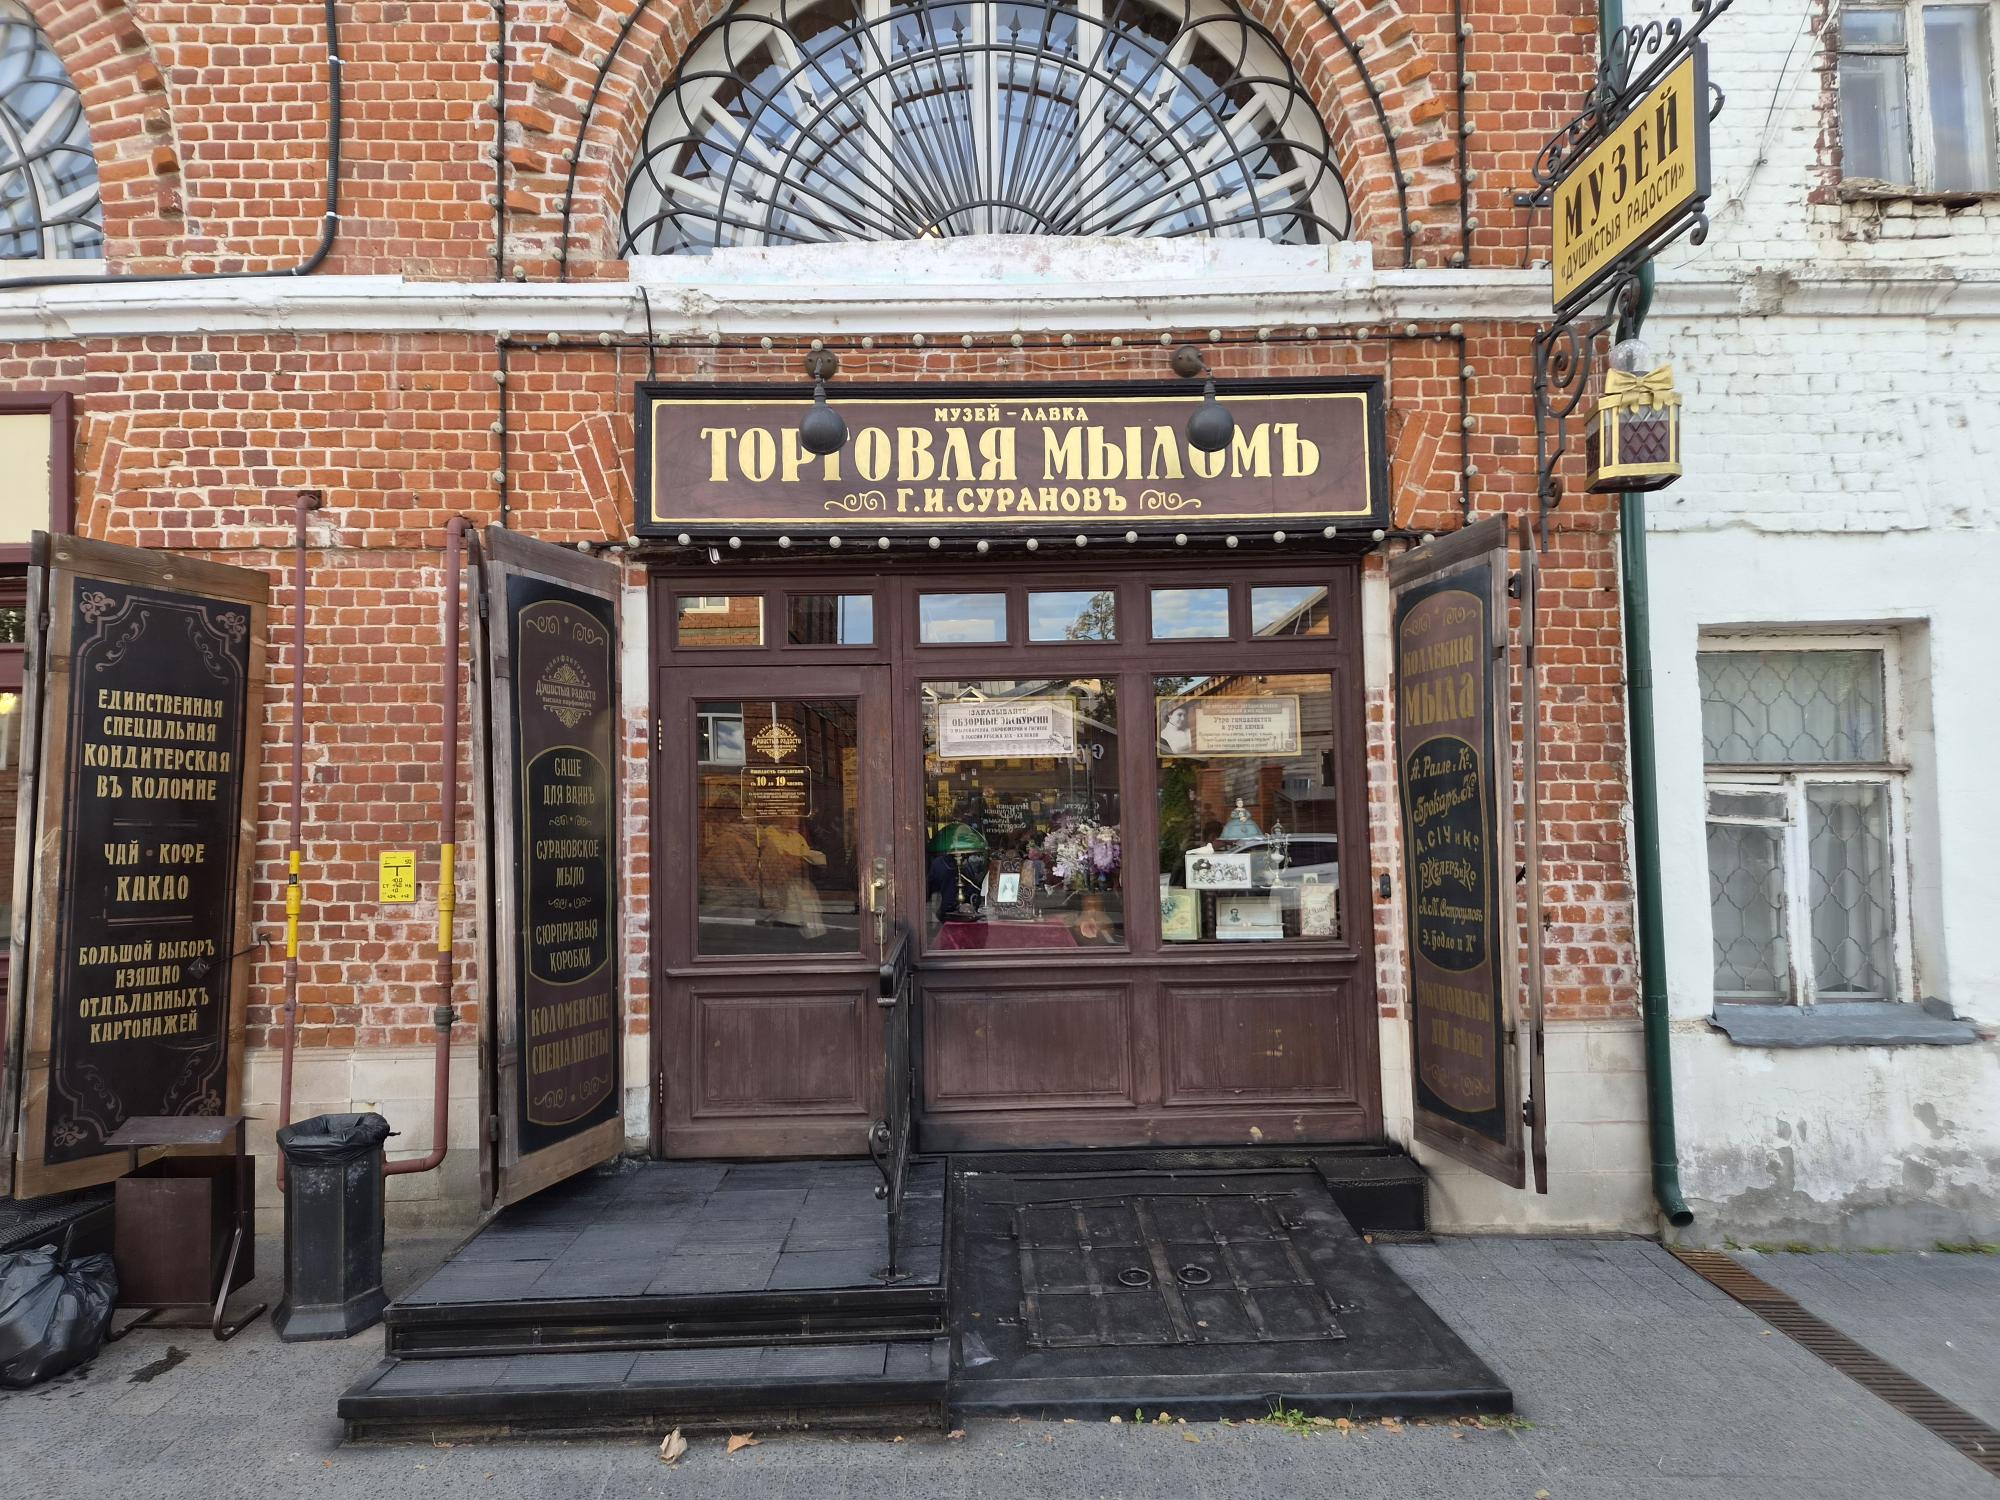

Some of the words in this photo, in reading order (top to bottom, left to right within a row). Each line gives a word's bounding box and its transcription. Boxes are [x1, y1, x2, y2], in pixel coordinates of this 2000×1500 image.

[1565, 86, 1678, 248] МУЗЕЙ
[1561, 214, 1621, 284] «ДУШИСТЫЯ
[1627, 163, 1685, 229] РАДОСТИ»
[98, 688, 224, 718] ЕДИНСТВЕННАЯ
[103, 716, 216, 742] СПЕЦІАЛЬНАЯ
[84, 743, 231, 773] КОНДИТЕРСКАЯ
[554, 757, 582, 777] САШЕ
[96, 775, 123, 798] ВЪ
[131, 776, 217, 801] КОЛОМНЕ
[756, 776, 767, 787] 10
[775, 776, 786, 787] 19
[543, 784, 563, 806] ДЛЯ
[566, 784, 595, 806] ВАННЪ
[104, 839, 139, 865] ЧАЙ
[159, 843, 205, 864] КОФЕ
[536, 839, 599, 860] СУРАНОВСКОЕ
[116, 874, 189, 902] КАКАО
[555, 866, 585, 888] МЫЛО
[535, 918, 598, 946] СЮРПРИЗНЫЯ
[79, 940, 153, 966] БОЛЬШОЙ
[158, 939, 215, 960] ВЫБОРЪ
[550, 946, 591, 973] КОРОБКИ
[115, 965, 180, 989] ИЗЯЩНО
[90, 1009, 198, 1044] КАРТОНАЖЕЙ
